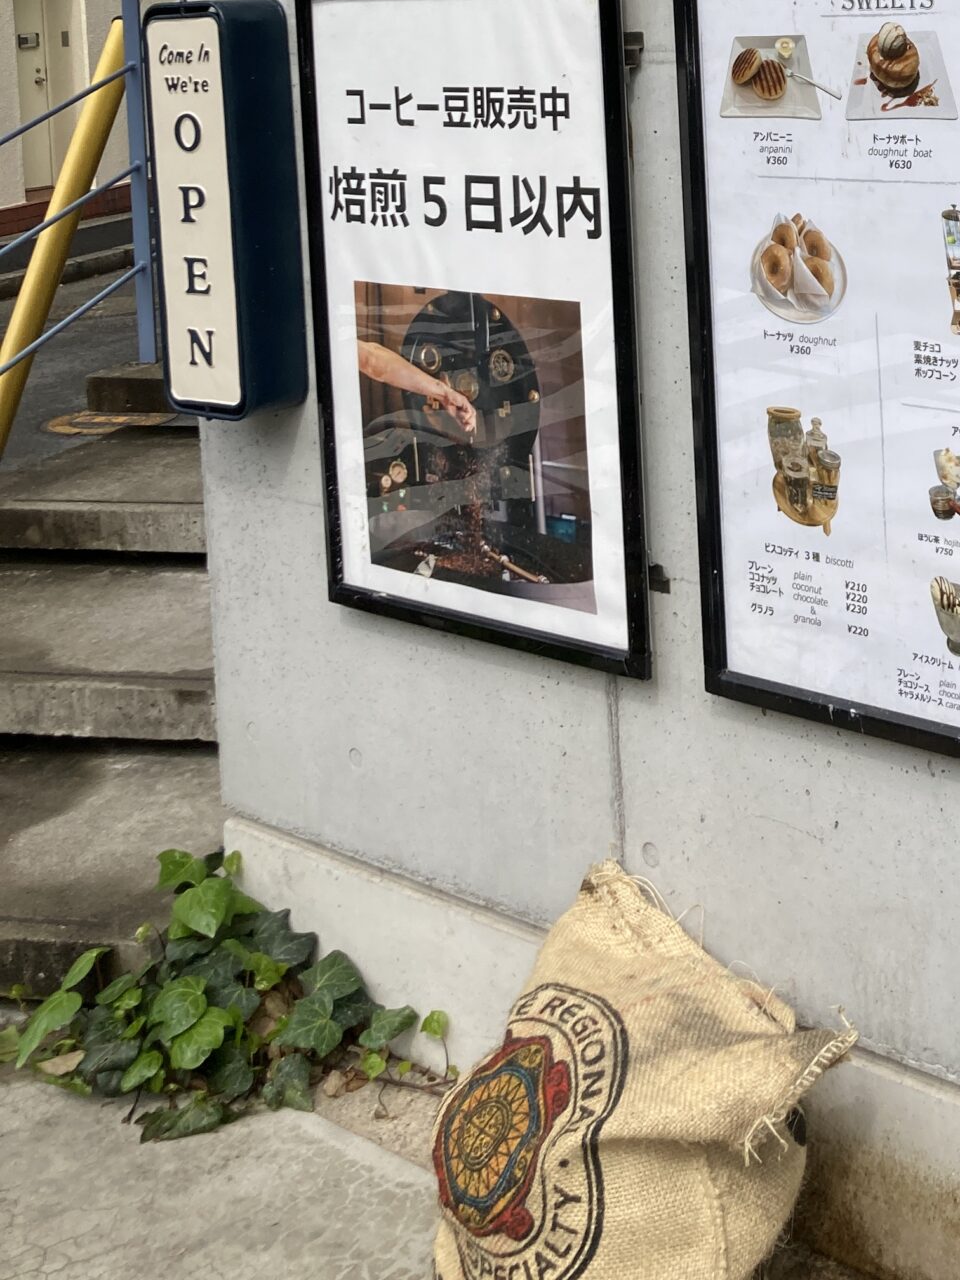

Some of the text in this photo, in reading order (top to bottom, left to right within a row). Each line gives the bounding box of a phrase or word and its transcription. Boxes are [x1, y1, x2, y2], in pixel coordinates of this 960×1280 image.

[159, 43, 210, 65] Come In
[165, 77, 209, 93] We're
[346, 86, 570, 131] コーヒー豆販売中
[759, 145, 792, 154] anpanini
[868, 147, 932, 158] doughnut boat
[767, 156, 787, 165] ¥360
[889, 160, 912, 169] ¥630
[329, 166, 602, 239] 焙煎5日以内
[175, 113, 214, 366] OPEN
[799, 334, 836, 346] doughnut
[790, 345, 811, 355] ¥360
[826, 555, 854, 568] biscotti
[794, 571, 867, 592] plain ¥210
[792, 582, 868, 604] coconut ¥220
[793, 592, 867, 615] chocolate ¥230
[794, 614, 868, 636] granola ¥220
